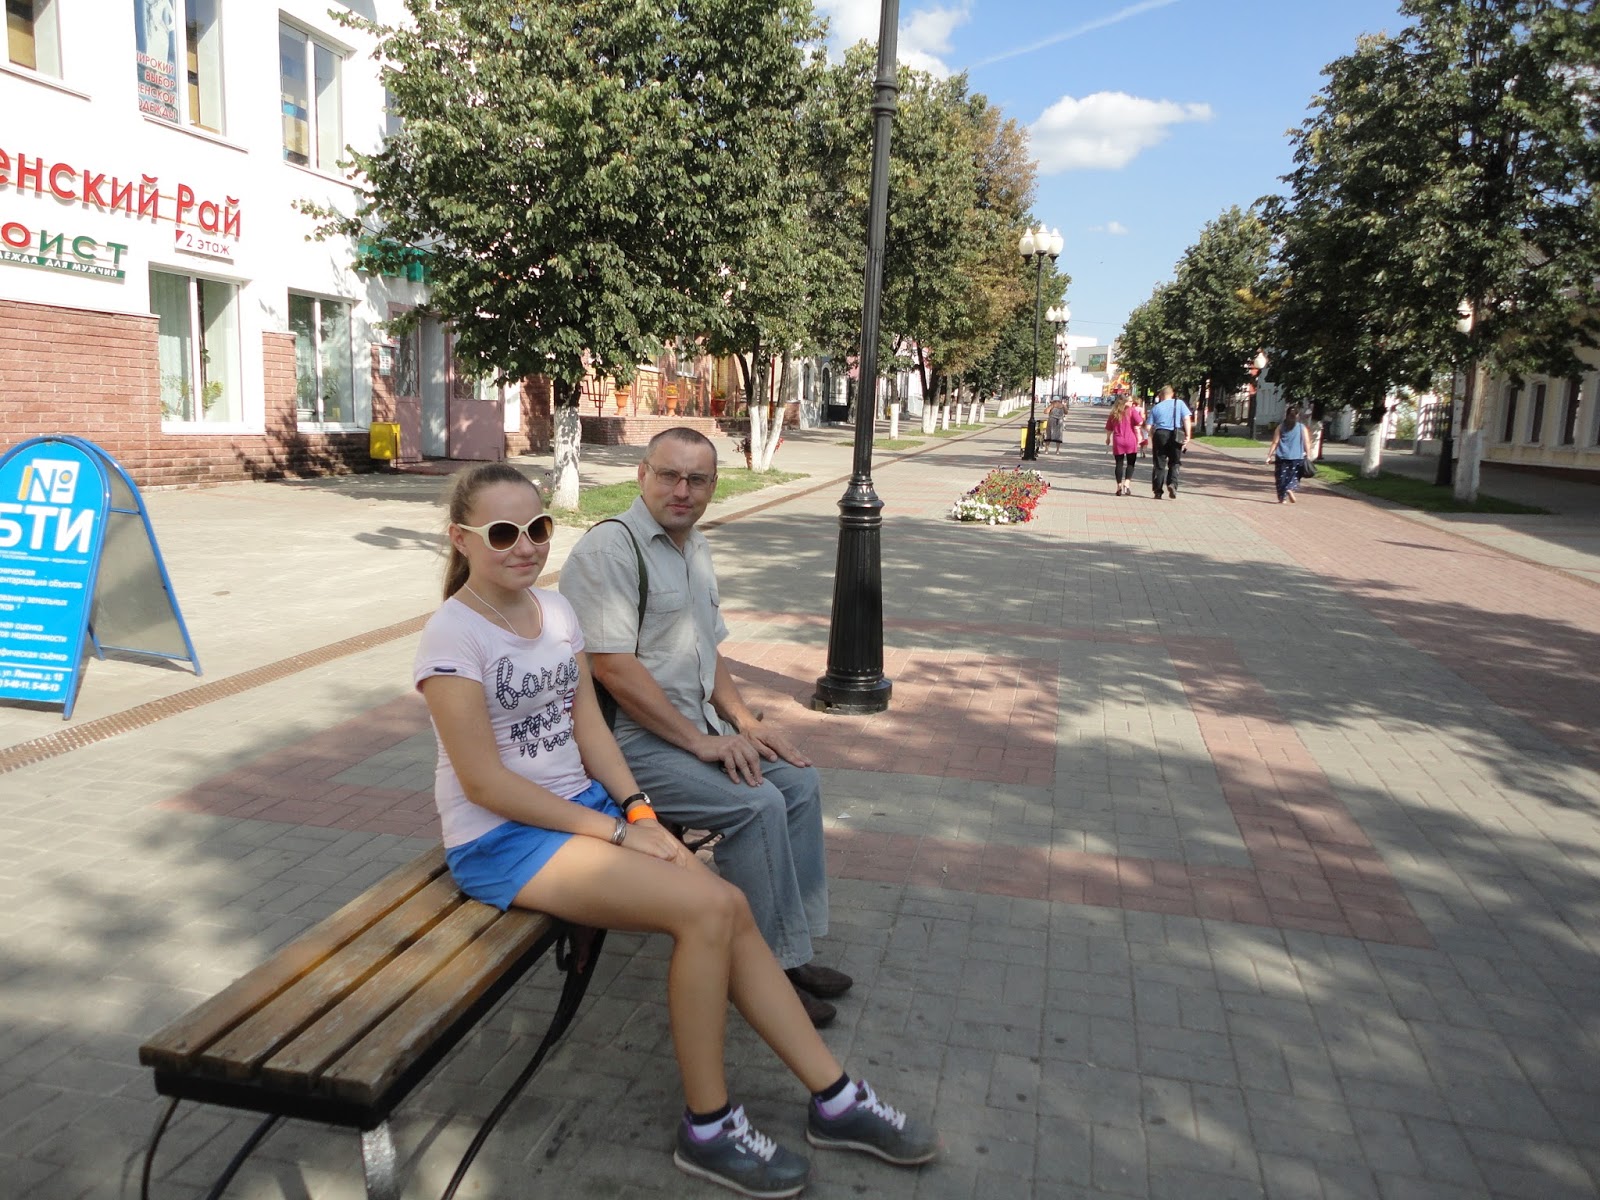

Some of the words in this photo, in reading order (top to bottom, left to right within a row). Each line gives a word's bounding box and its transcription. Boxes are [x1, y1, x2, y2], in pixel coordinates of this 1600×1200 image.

[145, 70, 175, 88] ВЫБОР
[138, 82, 176, 104] ЕНСКОЙ
[176, 183, 241, 237] Рай
[186, 233, 194, 248] 2
[197, 239, 231, 255] этаж
[45, 258, 69, 269] ДЛЯ
[72, 262, 118, 277] МУЖЧИН
[0, 502, 95, 553] БТИ
